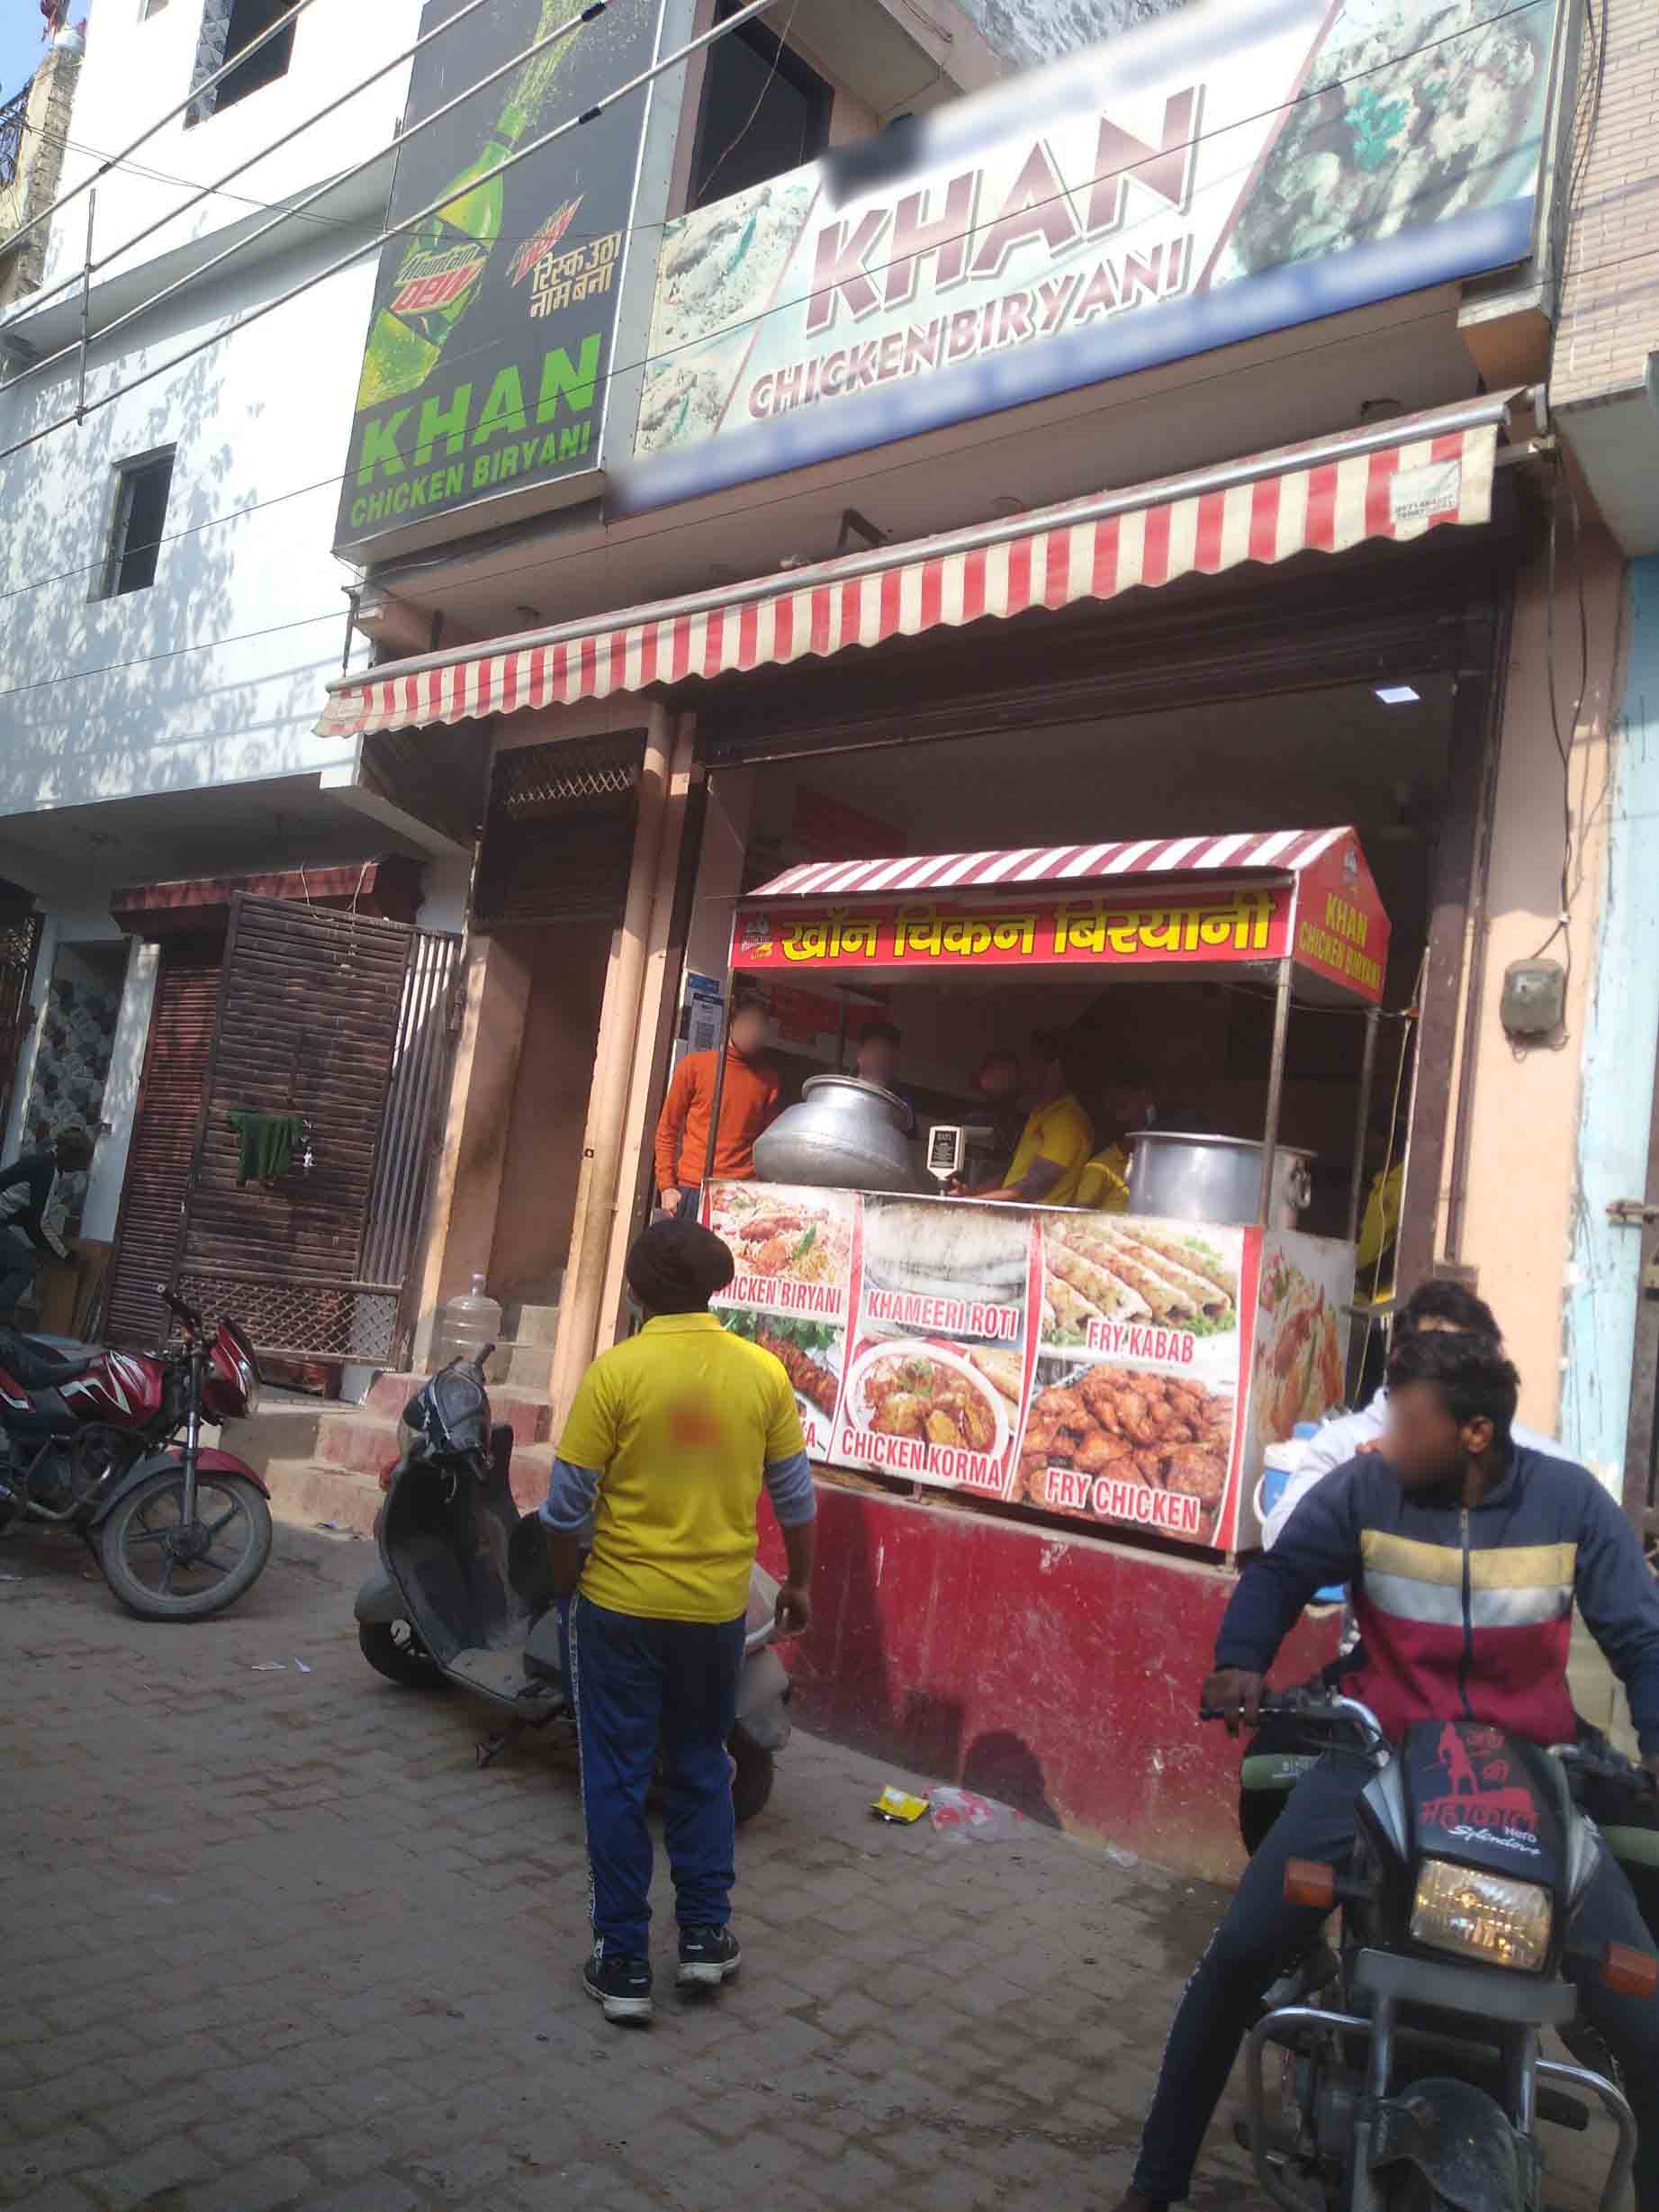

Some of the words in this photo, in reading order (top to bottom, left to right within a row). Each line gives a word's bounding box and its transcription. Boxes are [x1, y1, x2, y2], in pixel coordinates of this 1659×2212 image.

[806, 84, 1204, 340] KHAN
[529, 280, 573, 318] नाम
[572, 262, 615, 302] बना
[533, 247, 588, 294] रिस्क
[356, 332, 602, 486] KHAN
[351, 463, 465, 528] CHICKEN
[472, 421, 591, 490] BIRYANI
[890, 900, 1037, 957] चिकन
[1053, 889, 1276, 954] बिरयानी
[720, 1276, 777, 1305] HICKEN
[780, 1281, 842, 1314] BIRYANI
[868, 1290, 965, 1331] KHAMEERI
[970, 1305, 1018, 1339] ROTI
[1087, 1321, 1123, 1353] FRY
[1129, 1326, 1195, 1365] KABAB
[842, 1429, 924, 1471] CHICKEN
[929, 1446, 1001, 1487] KORMA
[1047, 1471, 1089, 1504] FRY
[1095, 1481, 1198, 1530] CHICKEN
[1504, 1826, 1537, 1844] Hero
